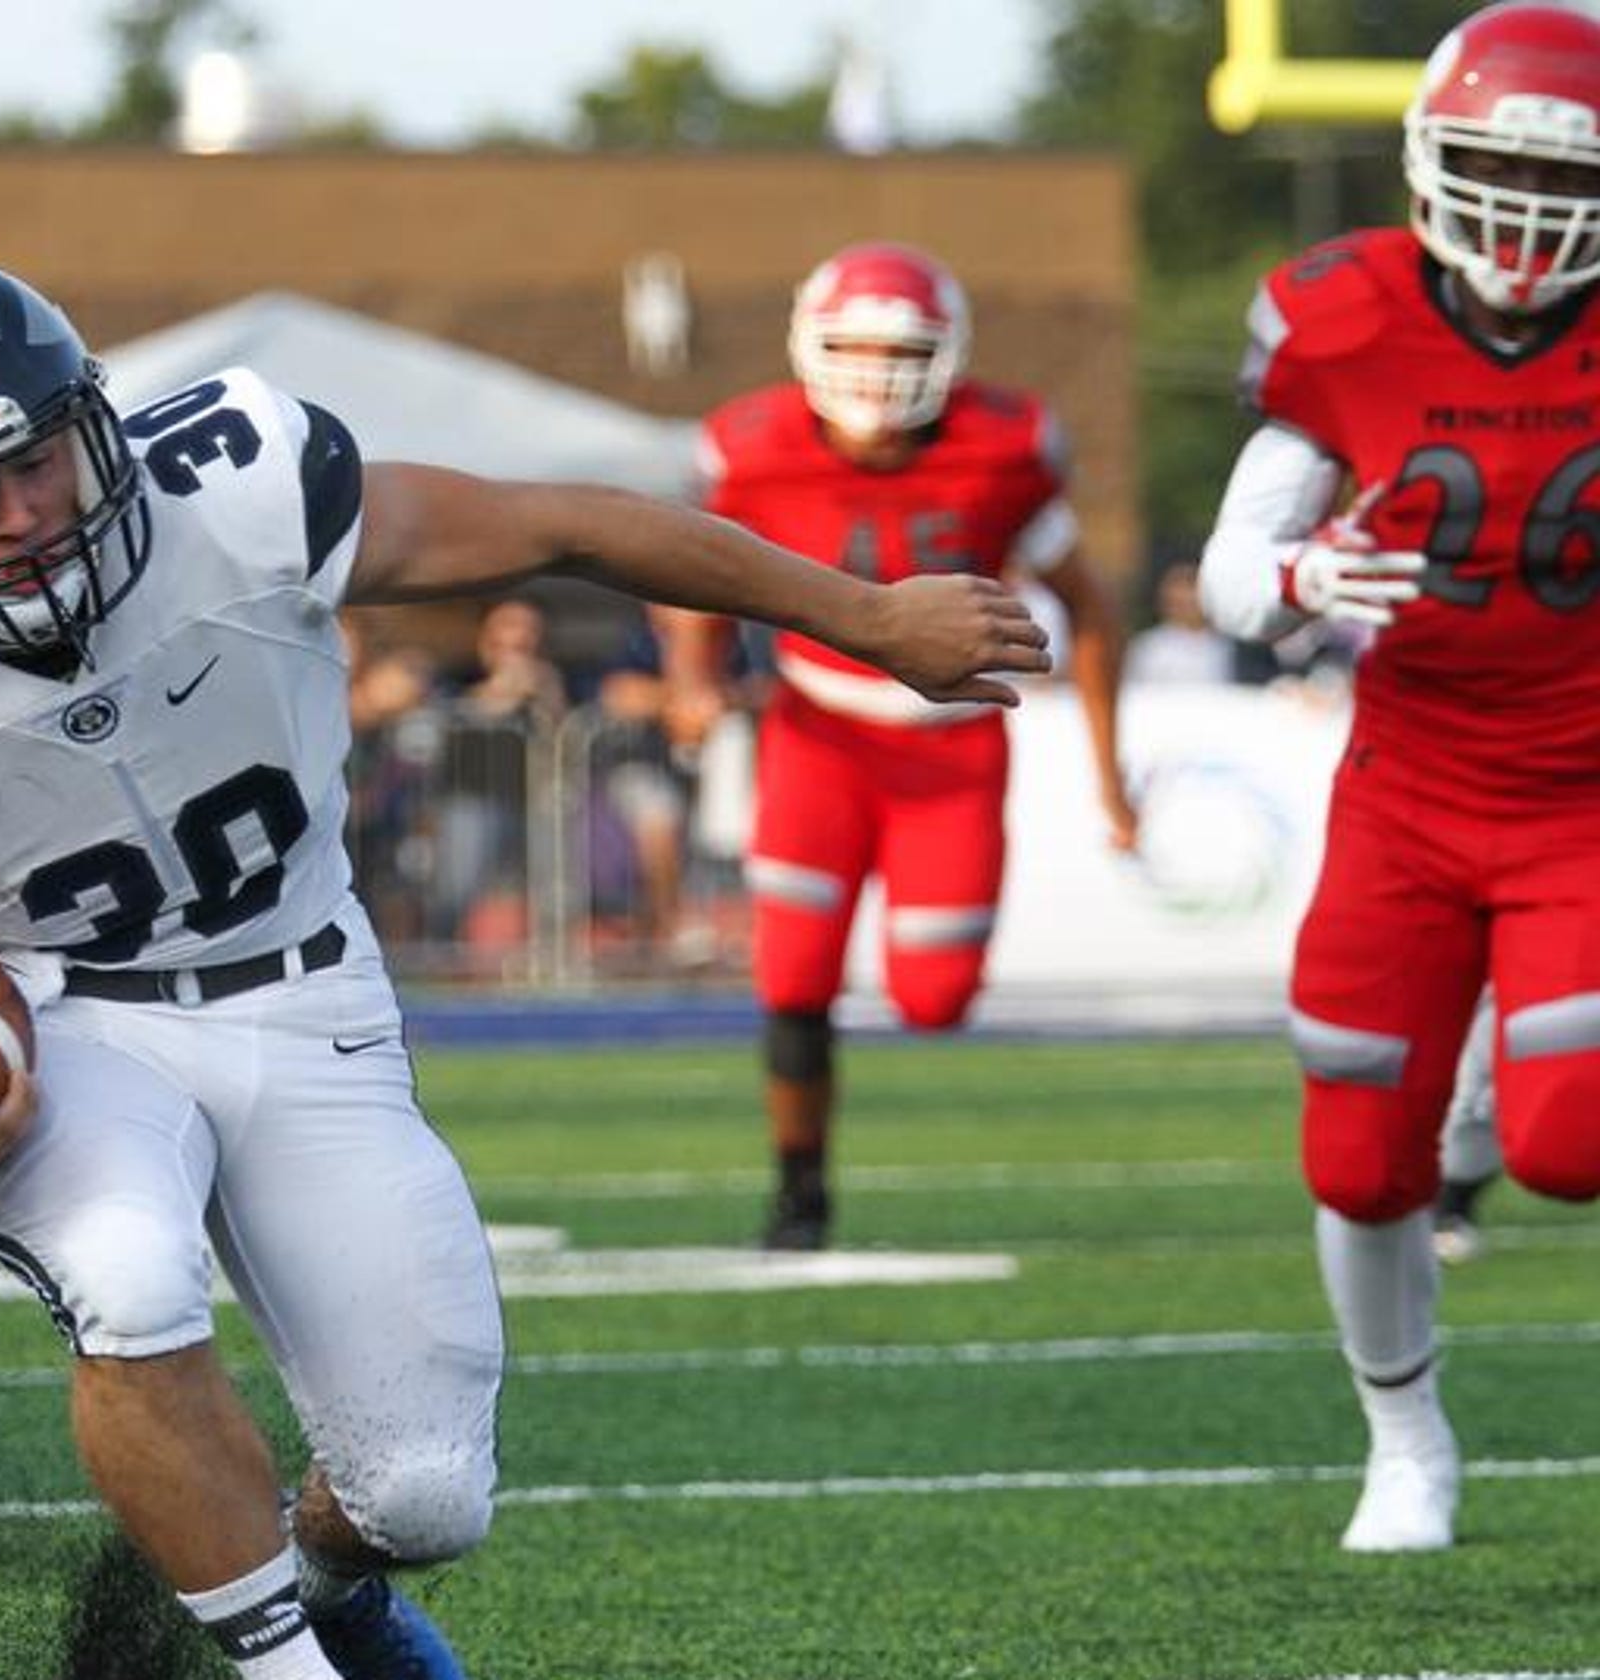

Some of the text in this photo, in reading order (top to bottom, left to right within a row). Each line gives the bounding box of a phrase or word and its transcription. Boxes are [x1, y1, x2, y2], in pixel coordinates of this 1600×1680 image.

[121, 379, 263, 497] 30
[1396, 443, 1600, 612] 26
[20, 764, 309, 962] 30
